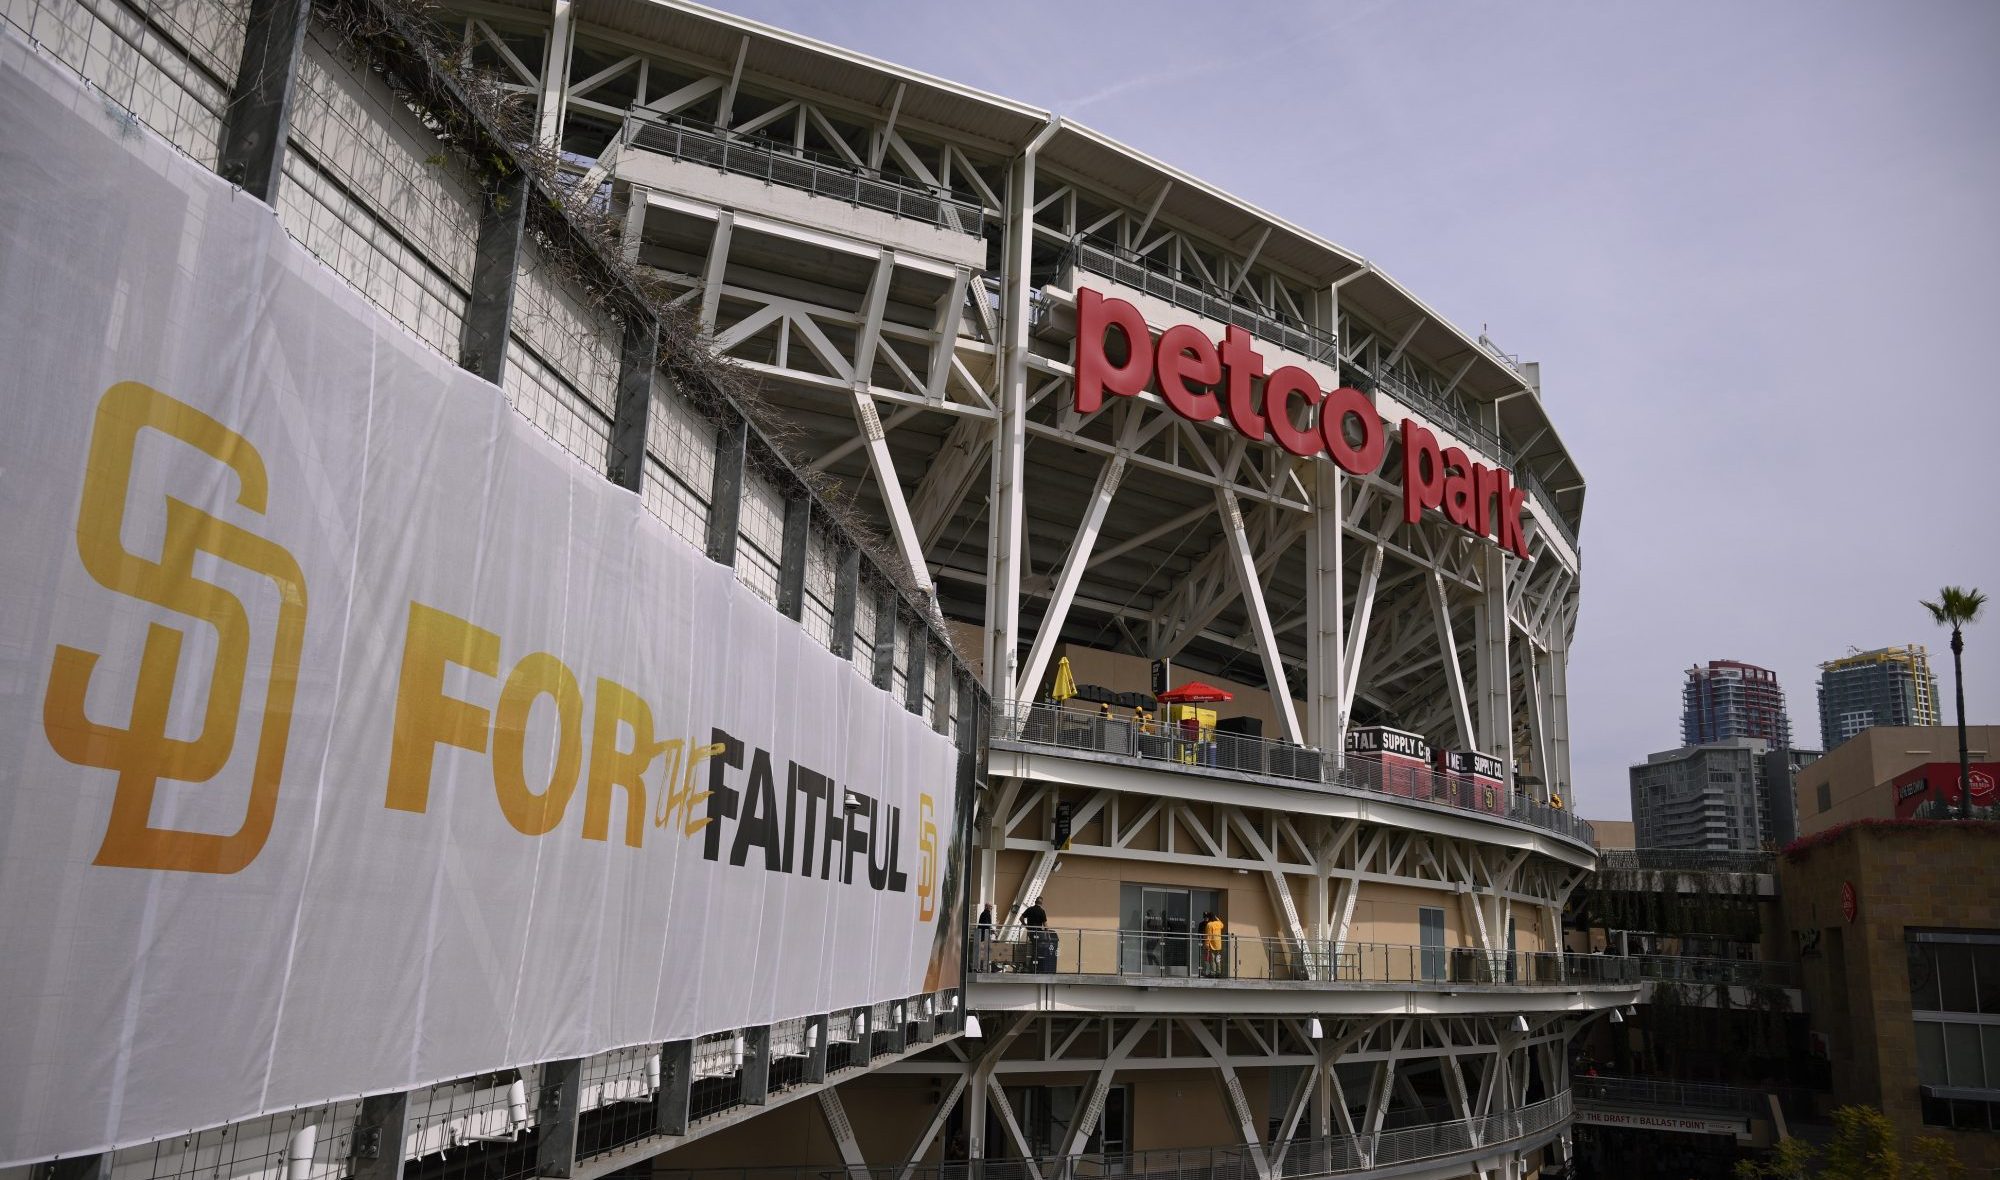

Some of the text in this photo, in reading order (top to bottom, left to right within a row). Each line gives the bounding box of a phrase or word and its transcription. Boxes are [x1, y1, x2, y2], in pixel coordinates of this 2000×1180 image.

[1074, 286, 1529, 561] petco park
[384, 600, 655, 849] FOR
[703, 727, 908, 893] FAITHFUL
[1345, 731, 1378, 750] ETAL
[1382, 732, 1415, 754] SUPPLY
[1474, 755, 1494, 776] SUPPLY
[1587, 1113, 1601, 1121] THE
[1604, 1114, 1630, 1123] DRAFT
[1639, 1117, 1677, 1127] BALLAST
[1679, 1120, 1706, 1129] POINT
